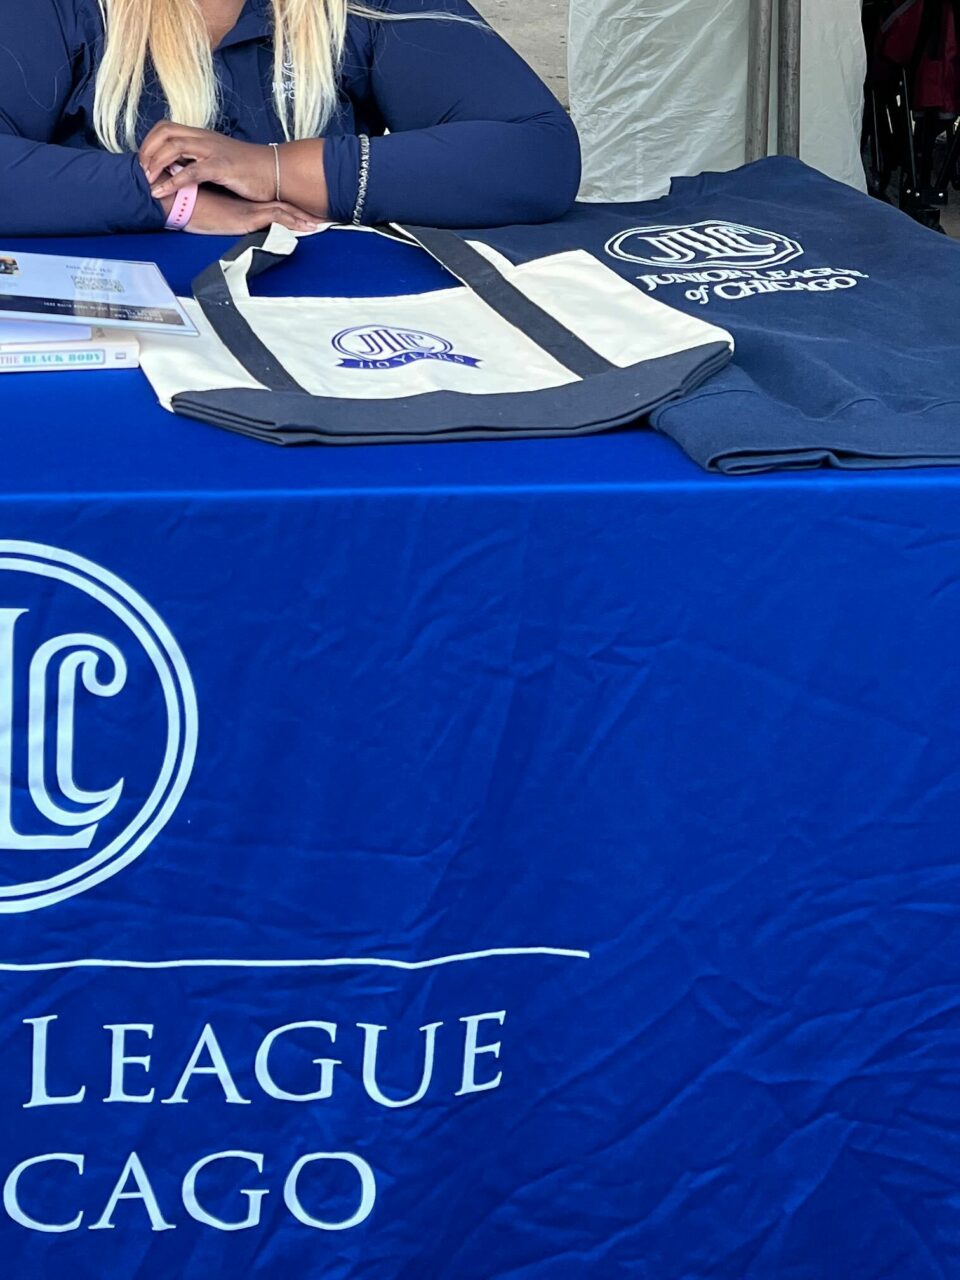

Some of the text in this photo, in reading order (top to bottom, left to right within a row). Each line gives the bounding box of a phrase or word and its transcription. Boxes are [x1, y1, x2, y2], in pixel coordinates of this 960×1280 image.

[637, 267, 869, 291] JUNIOR LEAGUE
[685, 276, 858, 304] of CHICAGO
[0, 355, 19, 365] THE
[22, 354, 64, 363] BLACK
[68, 353, 101, 362] BODY
[359, 352, 465, 369] 110 YEARS
[22, 1009, 507, 1110] LEAGUE
